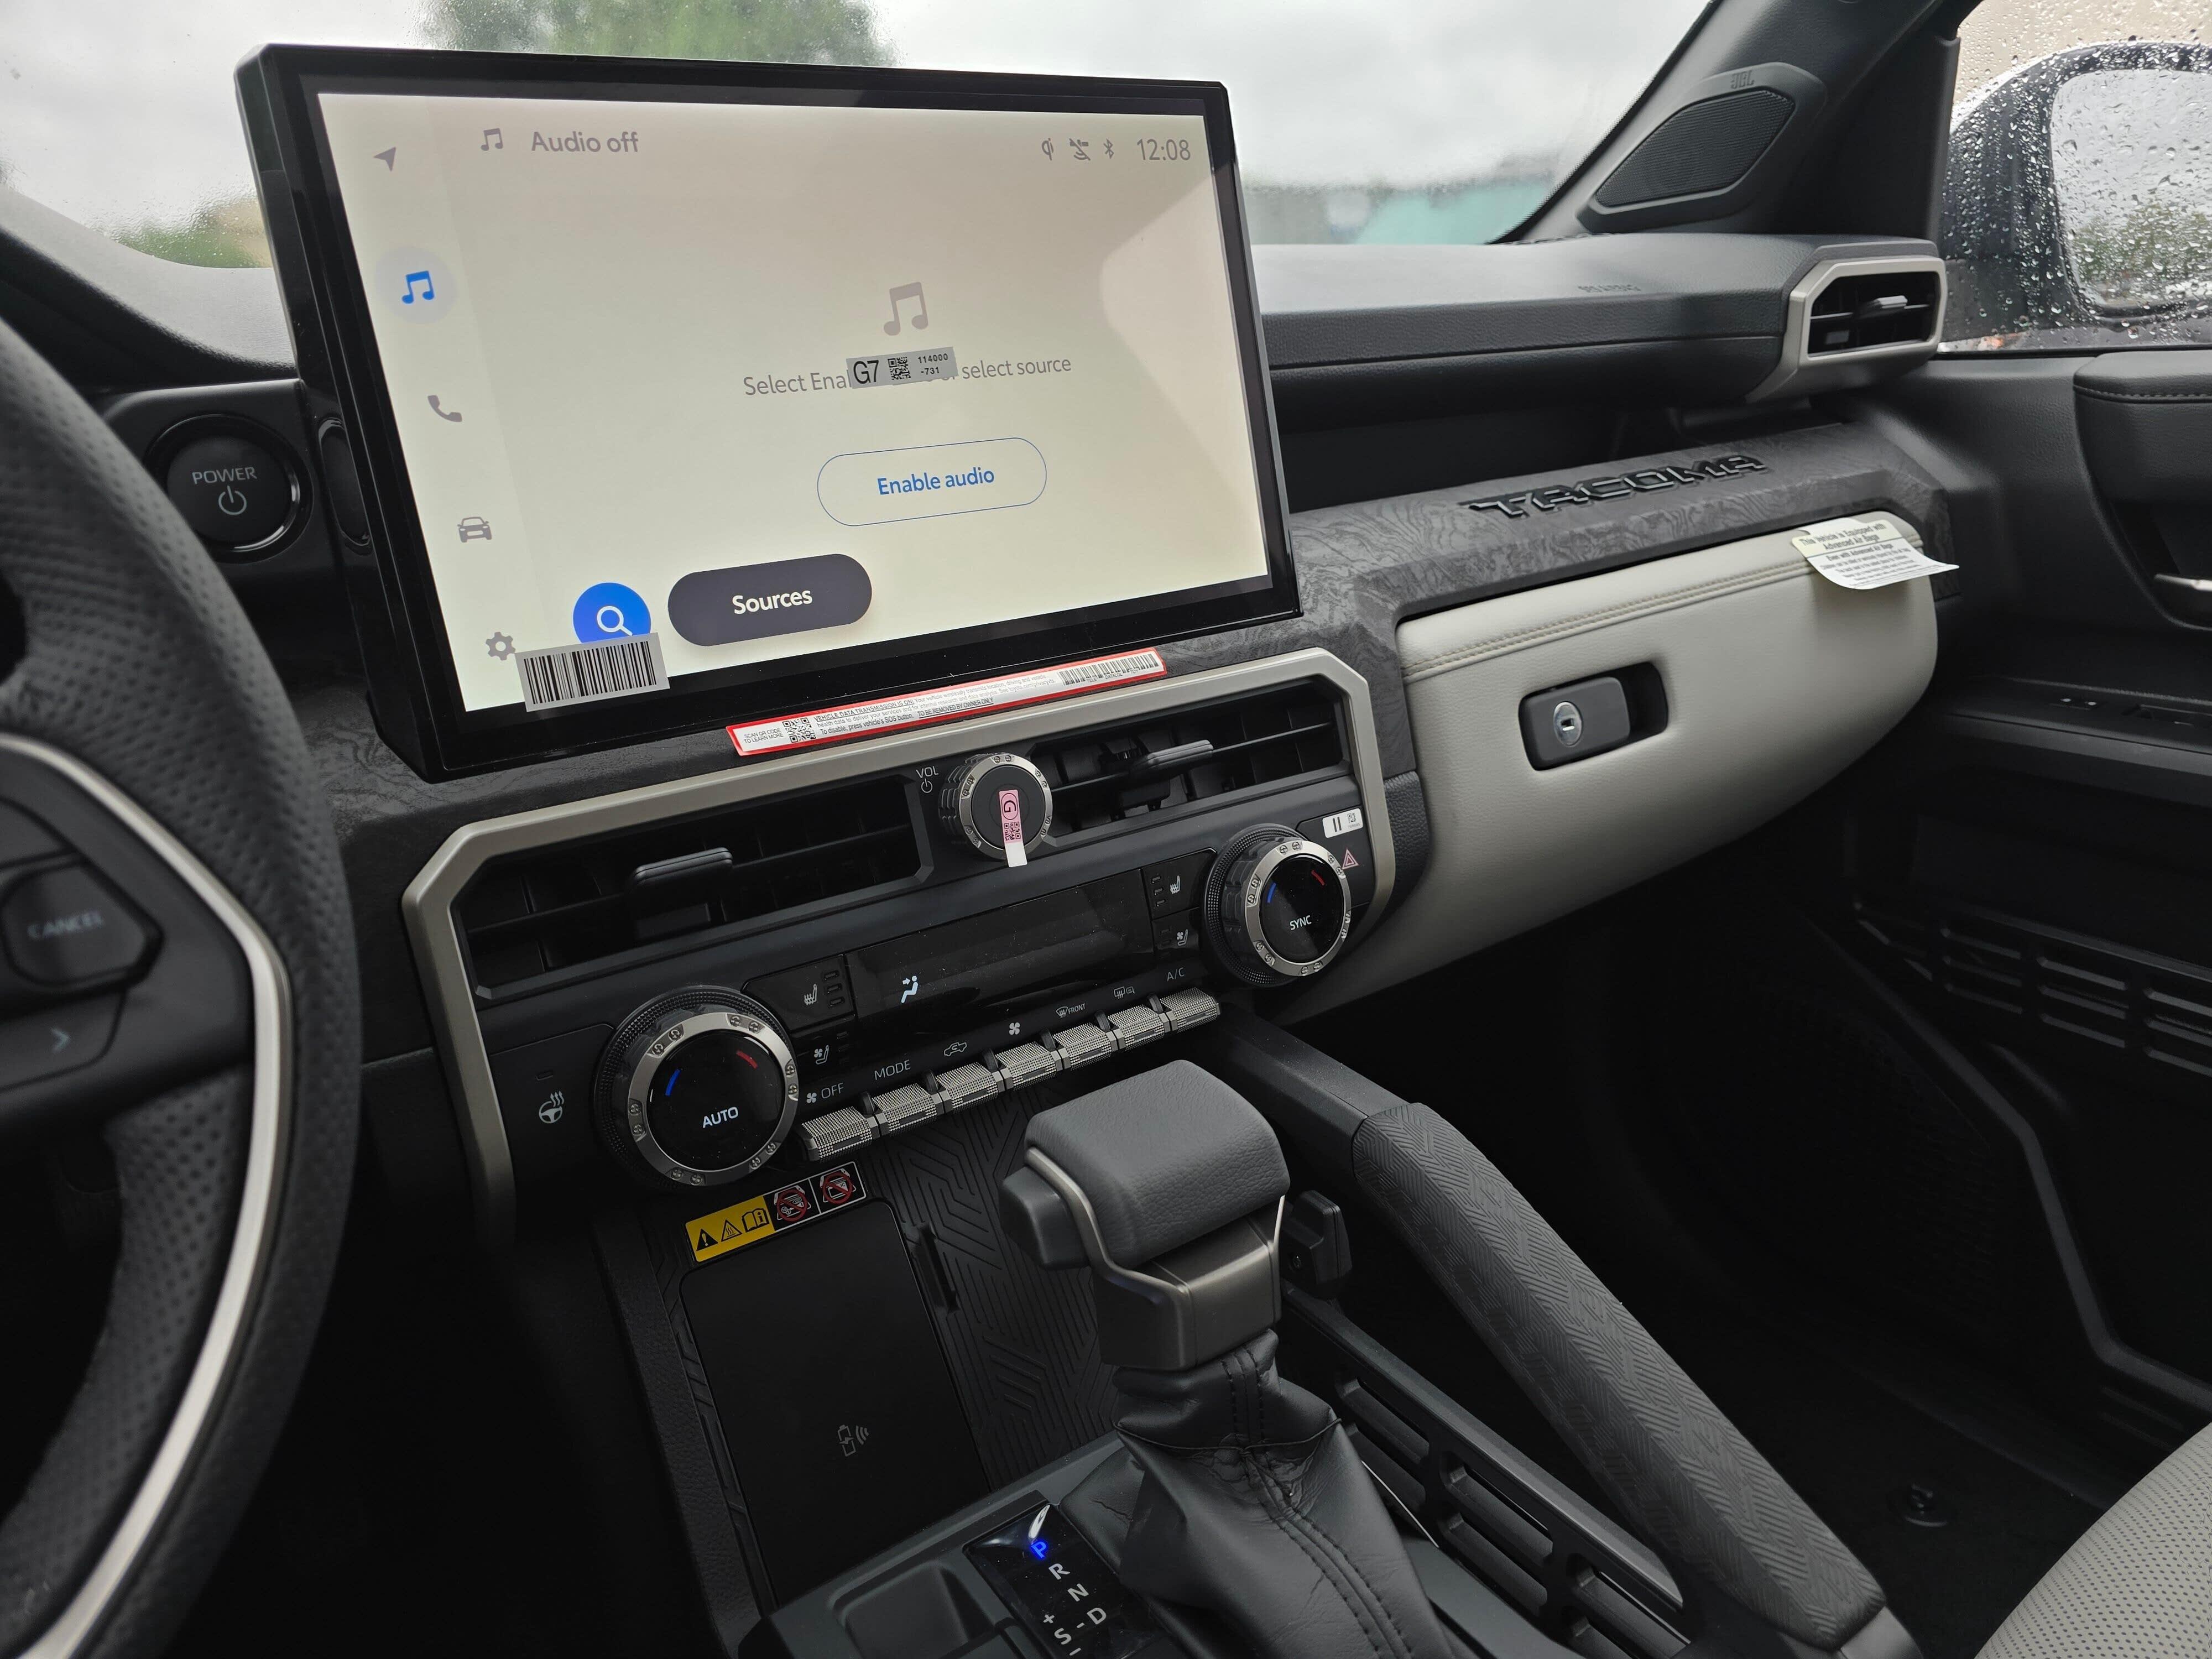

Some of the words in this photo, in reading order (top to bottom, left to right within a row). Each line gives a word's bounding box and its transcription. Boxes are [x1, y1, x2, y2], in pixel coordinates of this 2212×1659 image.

[531, 132, 601, 152] Audio
[607, 132, 639, 153] off
[1137, 139, 1191, 160] 12:08
[918, 353, 948, 363] 114000
[743, 374, 807, 395] Select
[962, 360, 1014, 379] select
[1016, 359, 1072, 375] source
[853, 359, 879, 384] G7
[921, 367, 940, 375] -731
[192, 466, 258, 484] POWER
[877, 472, 941, 495] Enable
[945, 467, 995, 488] audio
[1460, 455, 1767, 519] TACOMA
[732, 590, 813, 614] Sources
[813, 712, 838, 722] VEHICLE
[839, 709, 855, 718] DATA
[855, 703, 897, 714] TRANSMISSION
[828, 723, 848, 734] disable,
[848, 721, 863, 732] press
[863, 717, 885, 727] vehicle's
[897, 713, 915, 721] button.
[932, 703, 957, 713] REMOVED
[963, 700, 981, 708] OWNER
[853, 713, 870, 722] deliver
[870, 712, 882, 721] your
[882, 708, 902, 717] services
[916, 766, 939, 779] VOL
[1004, 800, 1016, 813] G
[1290, 915, 1312, 930] SYNC
[1166, 967, 1185, 982] A/C
[1068, 1003, 1086, 1015] FRONT
[874, 1059, 911, 1081] MODE
[821, 1082, 844, 1099] OFF
[702, 1107, 739, 1128] AUTO
[1030, 1541, 1047, 1558] P
[1048, 1563, 1071, 1580] R
[1067, 1583, 1089, 1601] N
[1087, 1608, 1107, 1625] D
[1054, 1627, 1072, 1645] S
